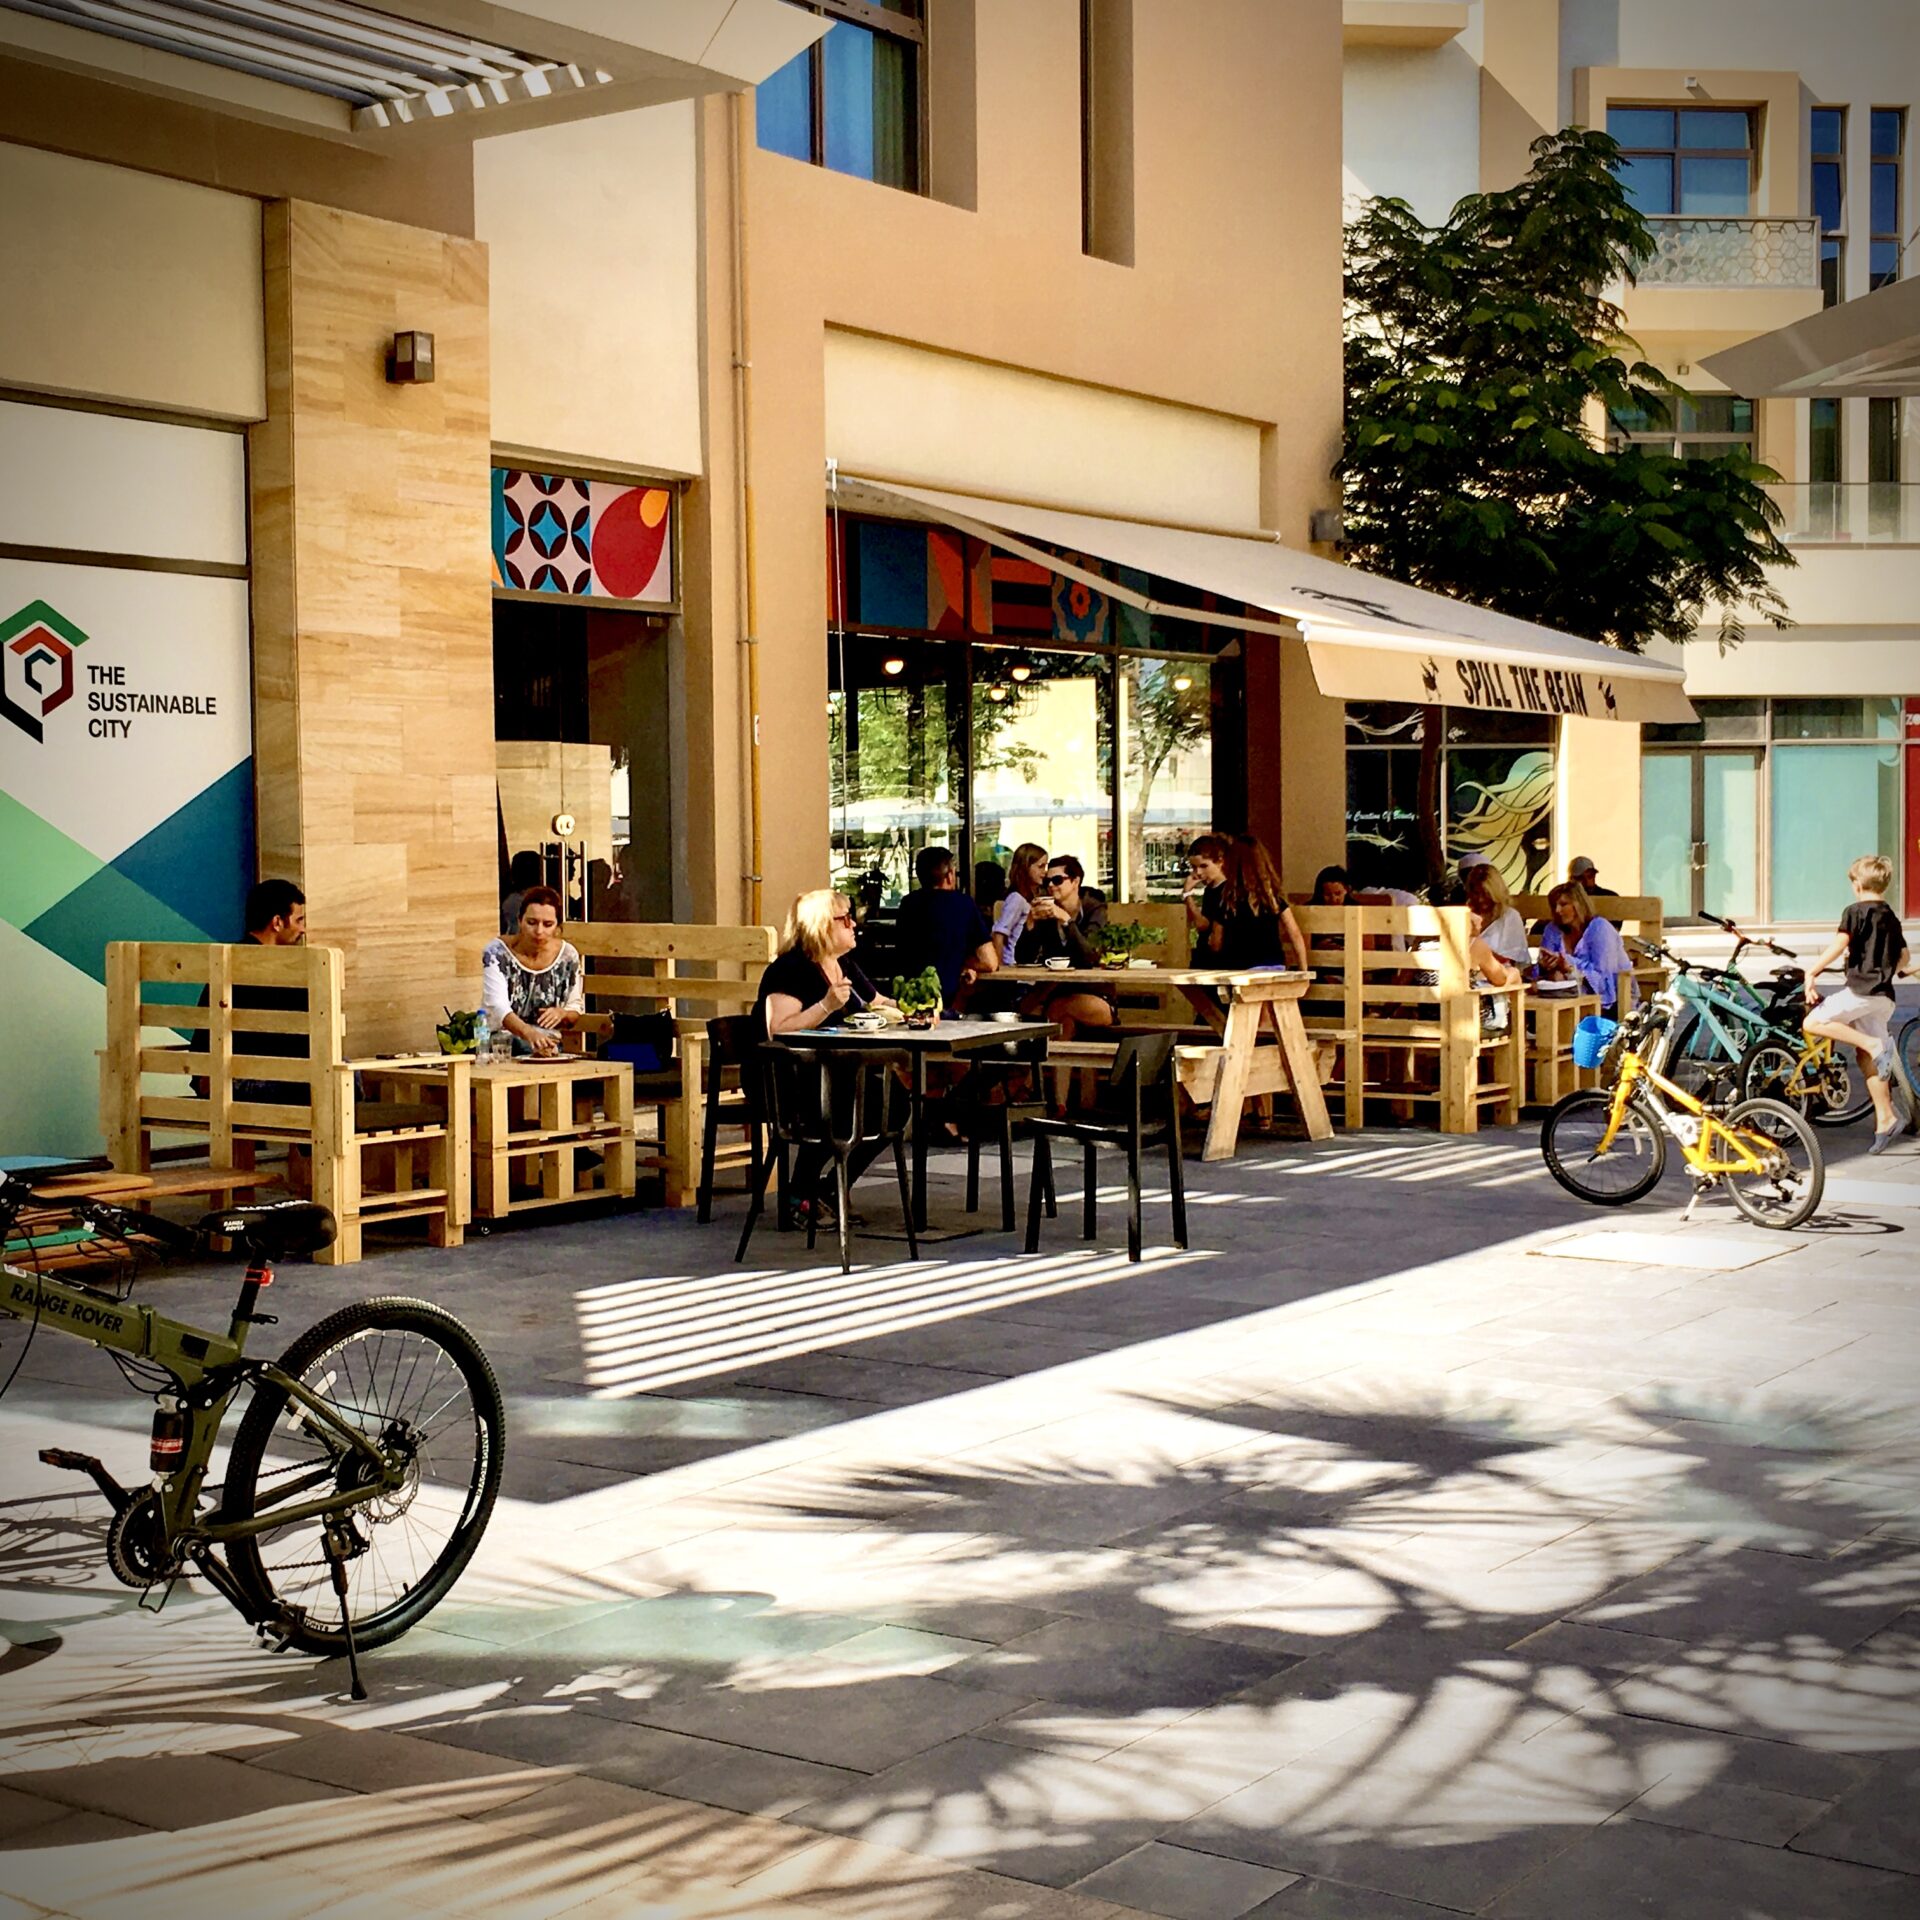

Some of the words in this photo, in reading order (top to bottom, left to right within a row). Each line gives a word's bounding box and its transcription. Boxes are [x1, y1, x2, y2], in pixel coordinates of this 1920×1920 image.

[87, 665, 125, 685] THE
[1456, 659, 1512, 708] SPILL
[1508, 665, 1547, 711] THE
[1544, 669, 1589, 717] BEAN
[88, 692, 216, 715] SUSTAINABLE
[88, 719, 131, 738] CITY
[10, 1283, 70, 1316] RANGE
[71, 1303, 123, 1333] ROVER
